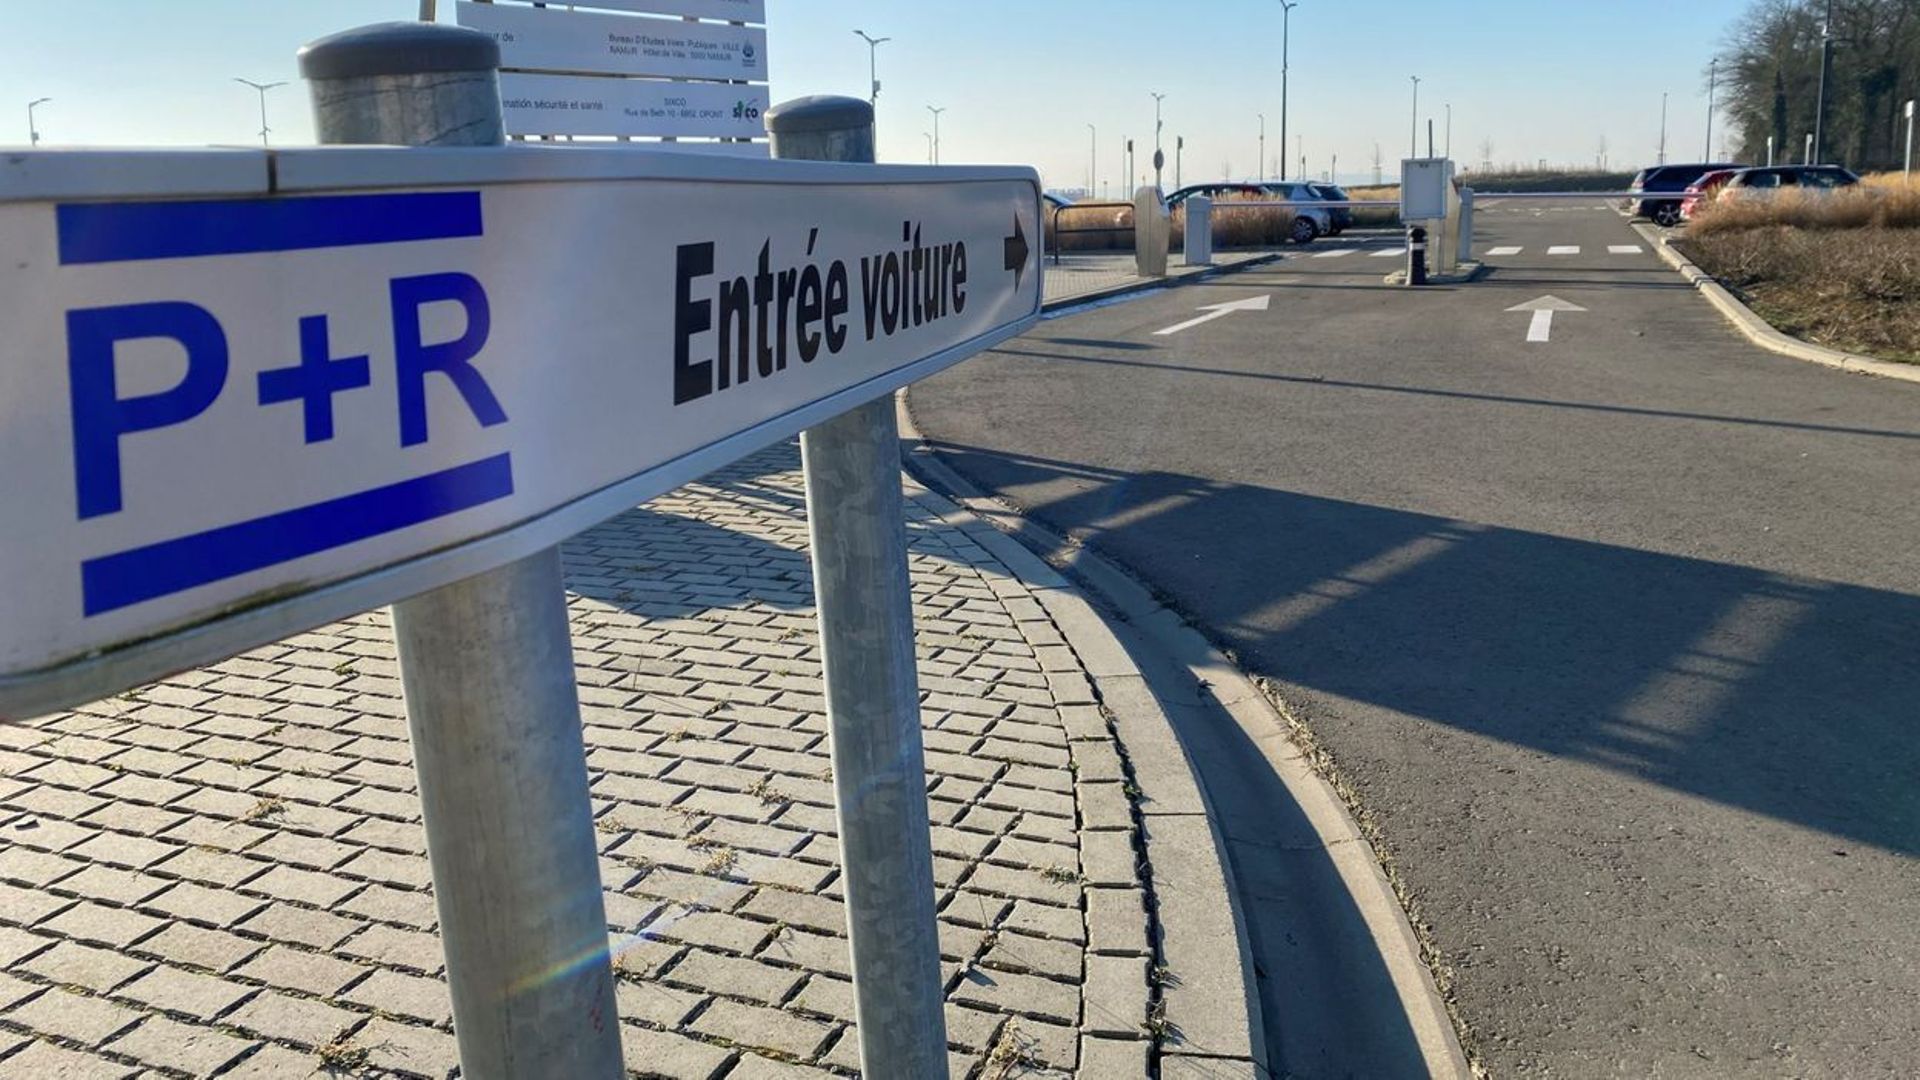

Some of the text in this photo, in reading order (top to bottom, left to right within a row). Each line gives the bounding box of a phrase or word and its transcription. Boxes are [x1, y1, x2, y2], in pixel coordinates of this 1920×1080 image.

[608, 32, 634, 44] Bureau
[569, 100, 578, 111] et
[624, 107, 638, 117] Rue
[640, 108, 649, 117] de
[674, 220, 967, 406] Entrée voiture
